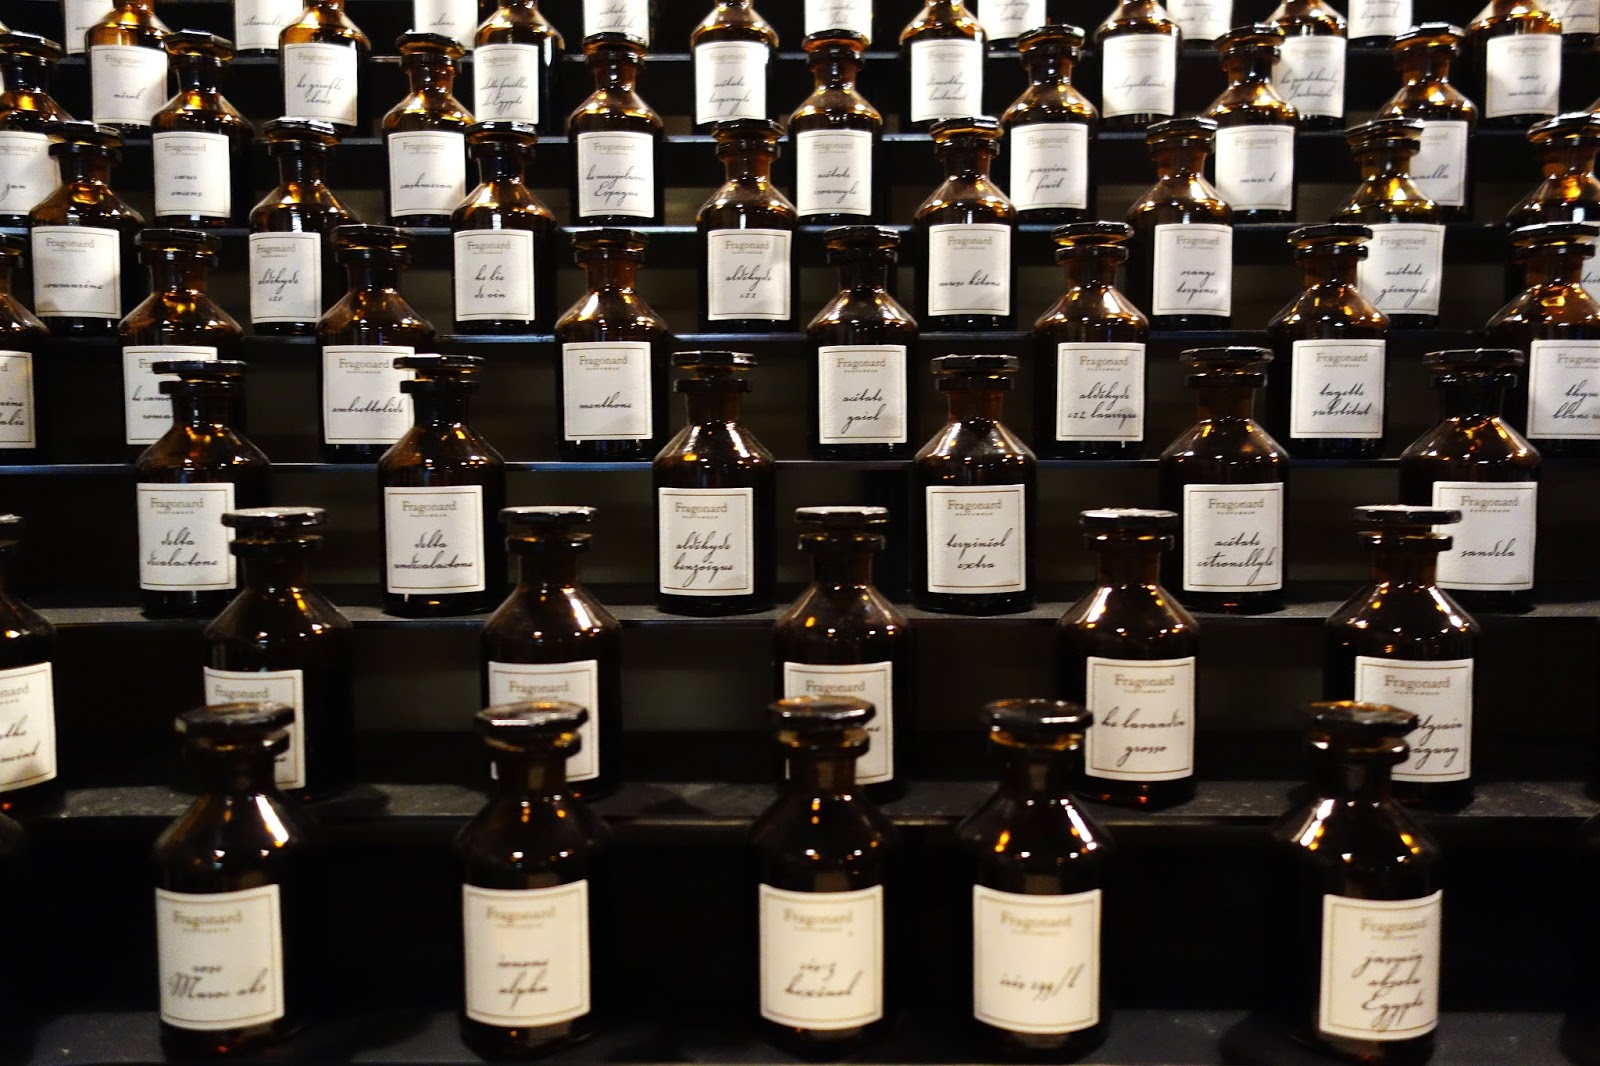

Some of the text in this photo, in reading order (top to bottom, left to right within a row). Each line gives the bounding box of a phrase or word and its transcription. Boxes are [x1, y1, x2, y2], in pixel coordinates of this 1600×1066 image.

[165, 142, 207, 155] Fragonard
[403, 142, 445, 153] Fragonard
[594, 142, 635, 154] Fragonard
[400, 173, 454, 190] cashmeran
[1026, 164, 1068, 185] passion
[593, 181, 640, 207] Espagne
[1032, 174, 1064, 203] fruit
[46, 237, 96, 251] Fragonard
[467, 241, 512, 254] Fragonard
[725, 241, 770, 253] Fragonard
[948, 236, 993, 249] Fragonard
[1176, 236, 1220, 248] Fragonard
[1380, 235, 1427, 248] Fragonard
[256, 244, 297, 257] Fragonard
[490, 265, 506, 282] lie
[1180, 266, 1216, 287] orange
[44, 280, 103, 291] coumarine
[474, 282, 507, 299] de vin
[339, 359, 390, 373] Fragonard
[579, 355, 629, 369] Fragonard
[836, 357, 886, 371] Fragonard
[1079, 355, 1129, 368] Fragonard
[1316, 352, 1368, 365] Fragonard
[332, 396, 404, 414] ambrettolide
[579, 392, 633, 409] menthone
[1312, 399, 1370, 416] substitut
[1090, 401, 1137, 430] laurique
[150, 497, 204, 511] Fragonard
[402, 501, 457, 515] Fragonard
[675, 501, 728, 516] Fragonard
[948, 499, 1002, 513] Fragonard
[1208, 497, 1264, 512] Fragonard
[1460, 495, 1519, 511] Fragonard
[161, 526, 195, 546] delta
[414, 529, 448, 549] delta
[956, 554, 995, 570] extra
[508, 679, 568, 696] Fragonard
[805, 679, 866, 695] Fragonard
[1113, 674, 1174, 690] Fragonard
[1384, 674, 1451, 691] Fragonard
[1120, 706, 1185, 730] lavandin
[1115, 744, 1167, 767] grosso
[172, 909, 242, 927] Fragonard
[486, 904, 557, 923] Fragonard
[783, 907, 853, 926] Fragonard
[1000, 909, 1072, 928] Fragonard
[1360, 916, 1428, 934] Fragonard
[497, 969, 549, 1011] alpha
